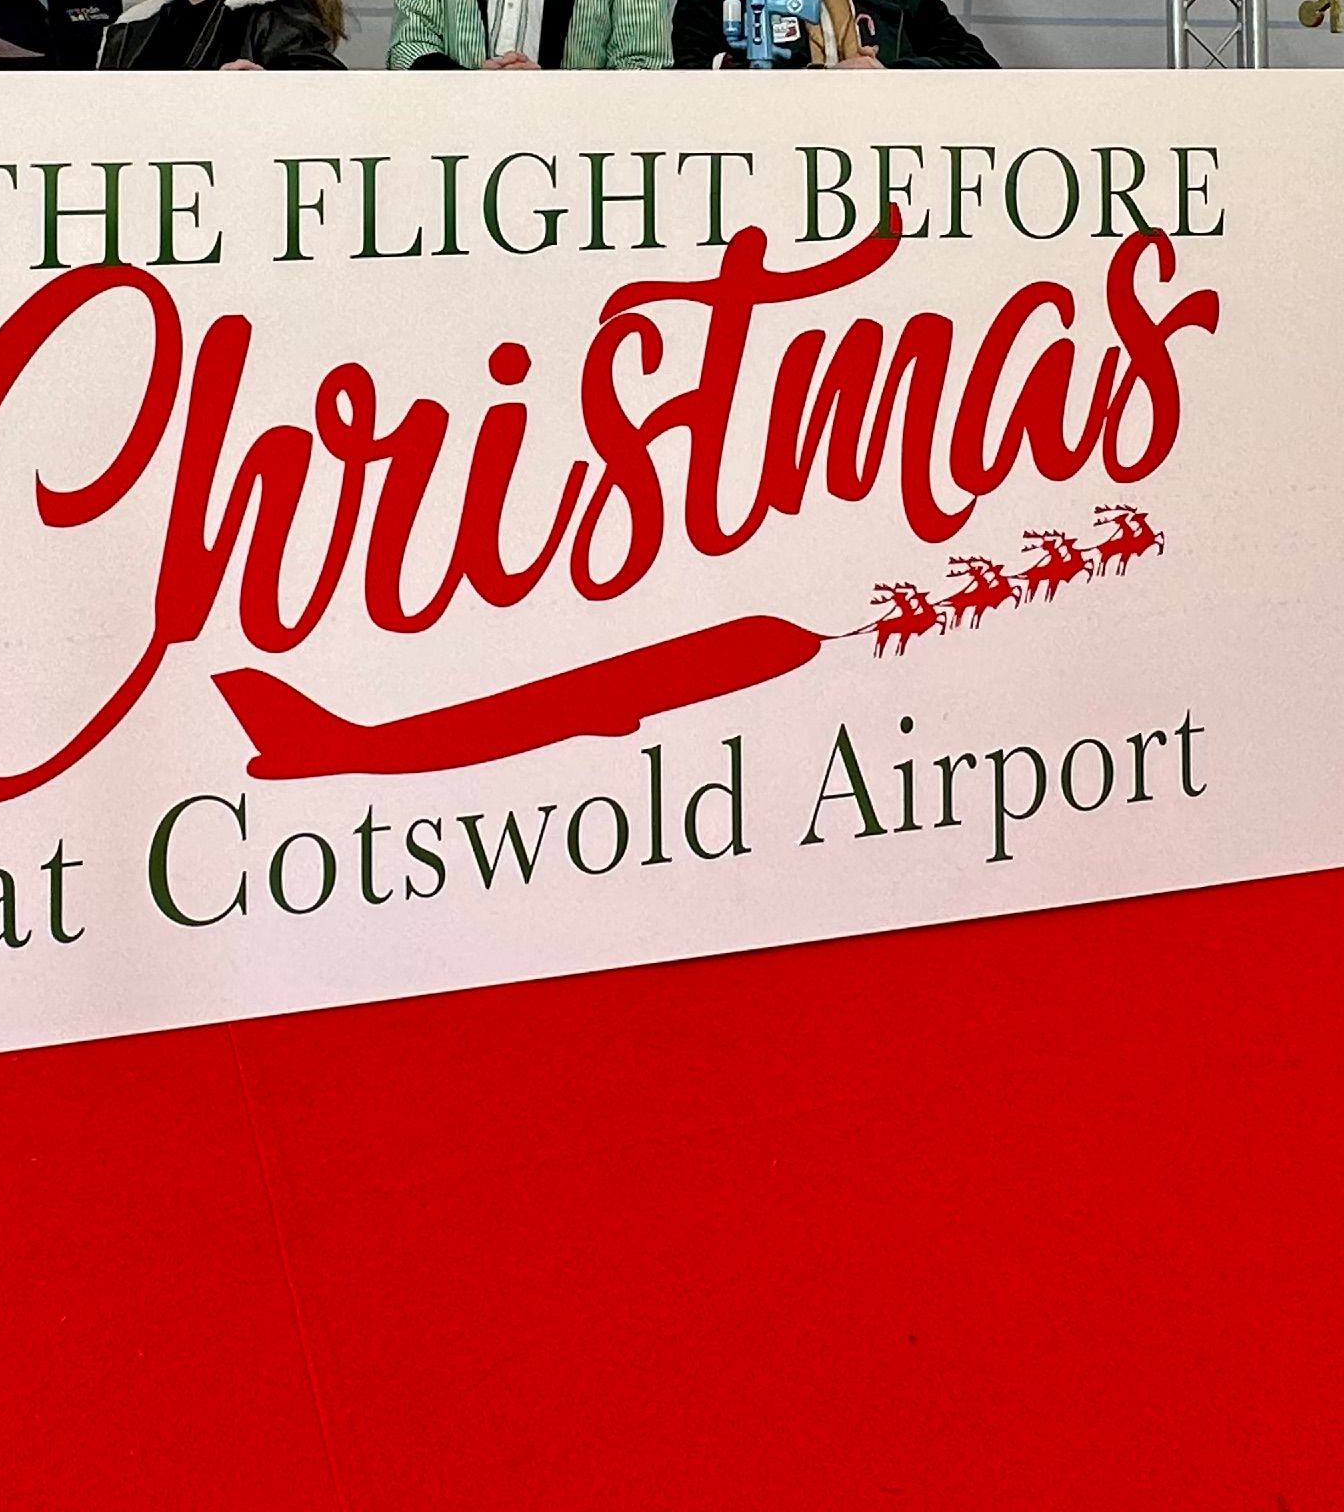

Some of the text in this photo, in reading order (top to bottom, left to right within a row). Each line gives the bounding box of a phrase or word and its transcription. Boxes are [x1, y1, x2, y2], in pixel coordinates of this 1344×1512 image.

[272, 150, 754, 263] FLIGHT
[793, 144, 1226, 244] BEFORE
[147, 734, 753, 928] Cotswold
[799, 708, 1209, 864] Airport
